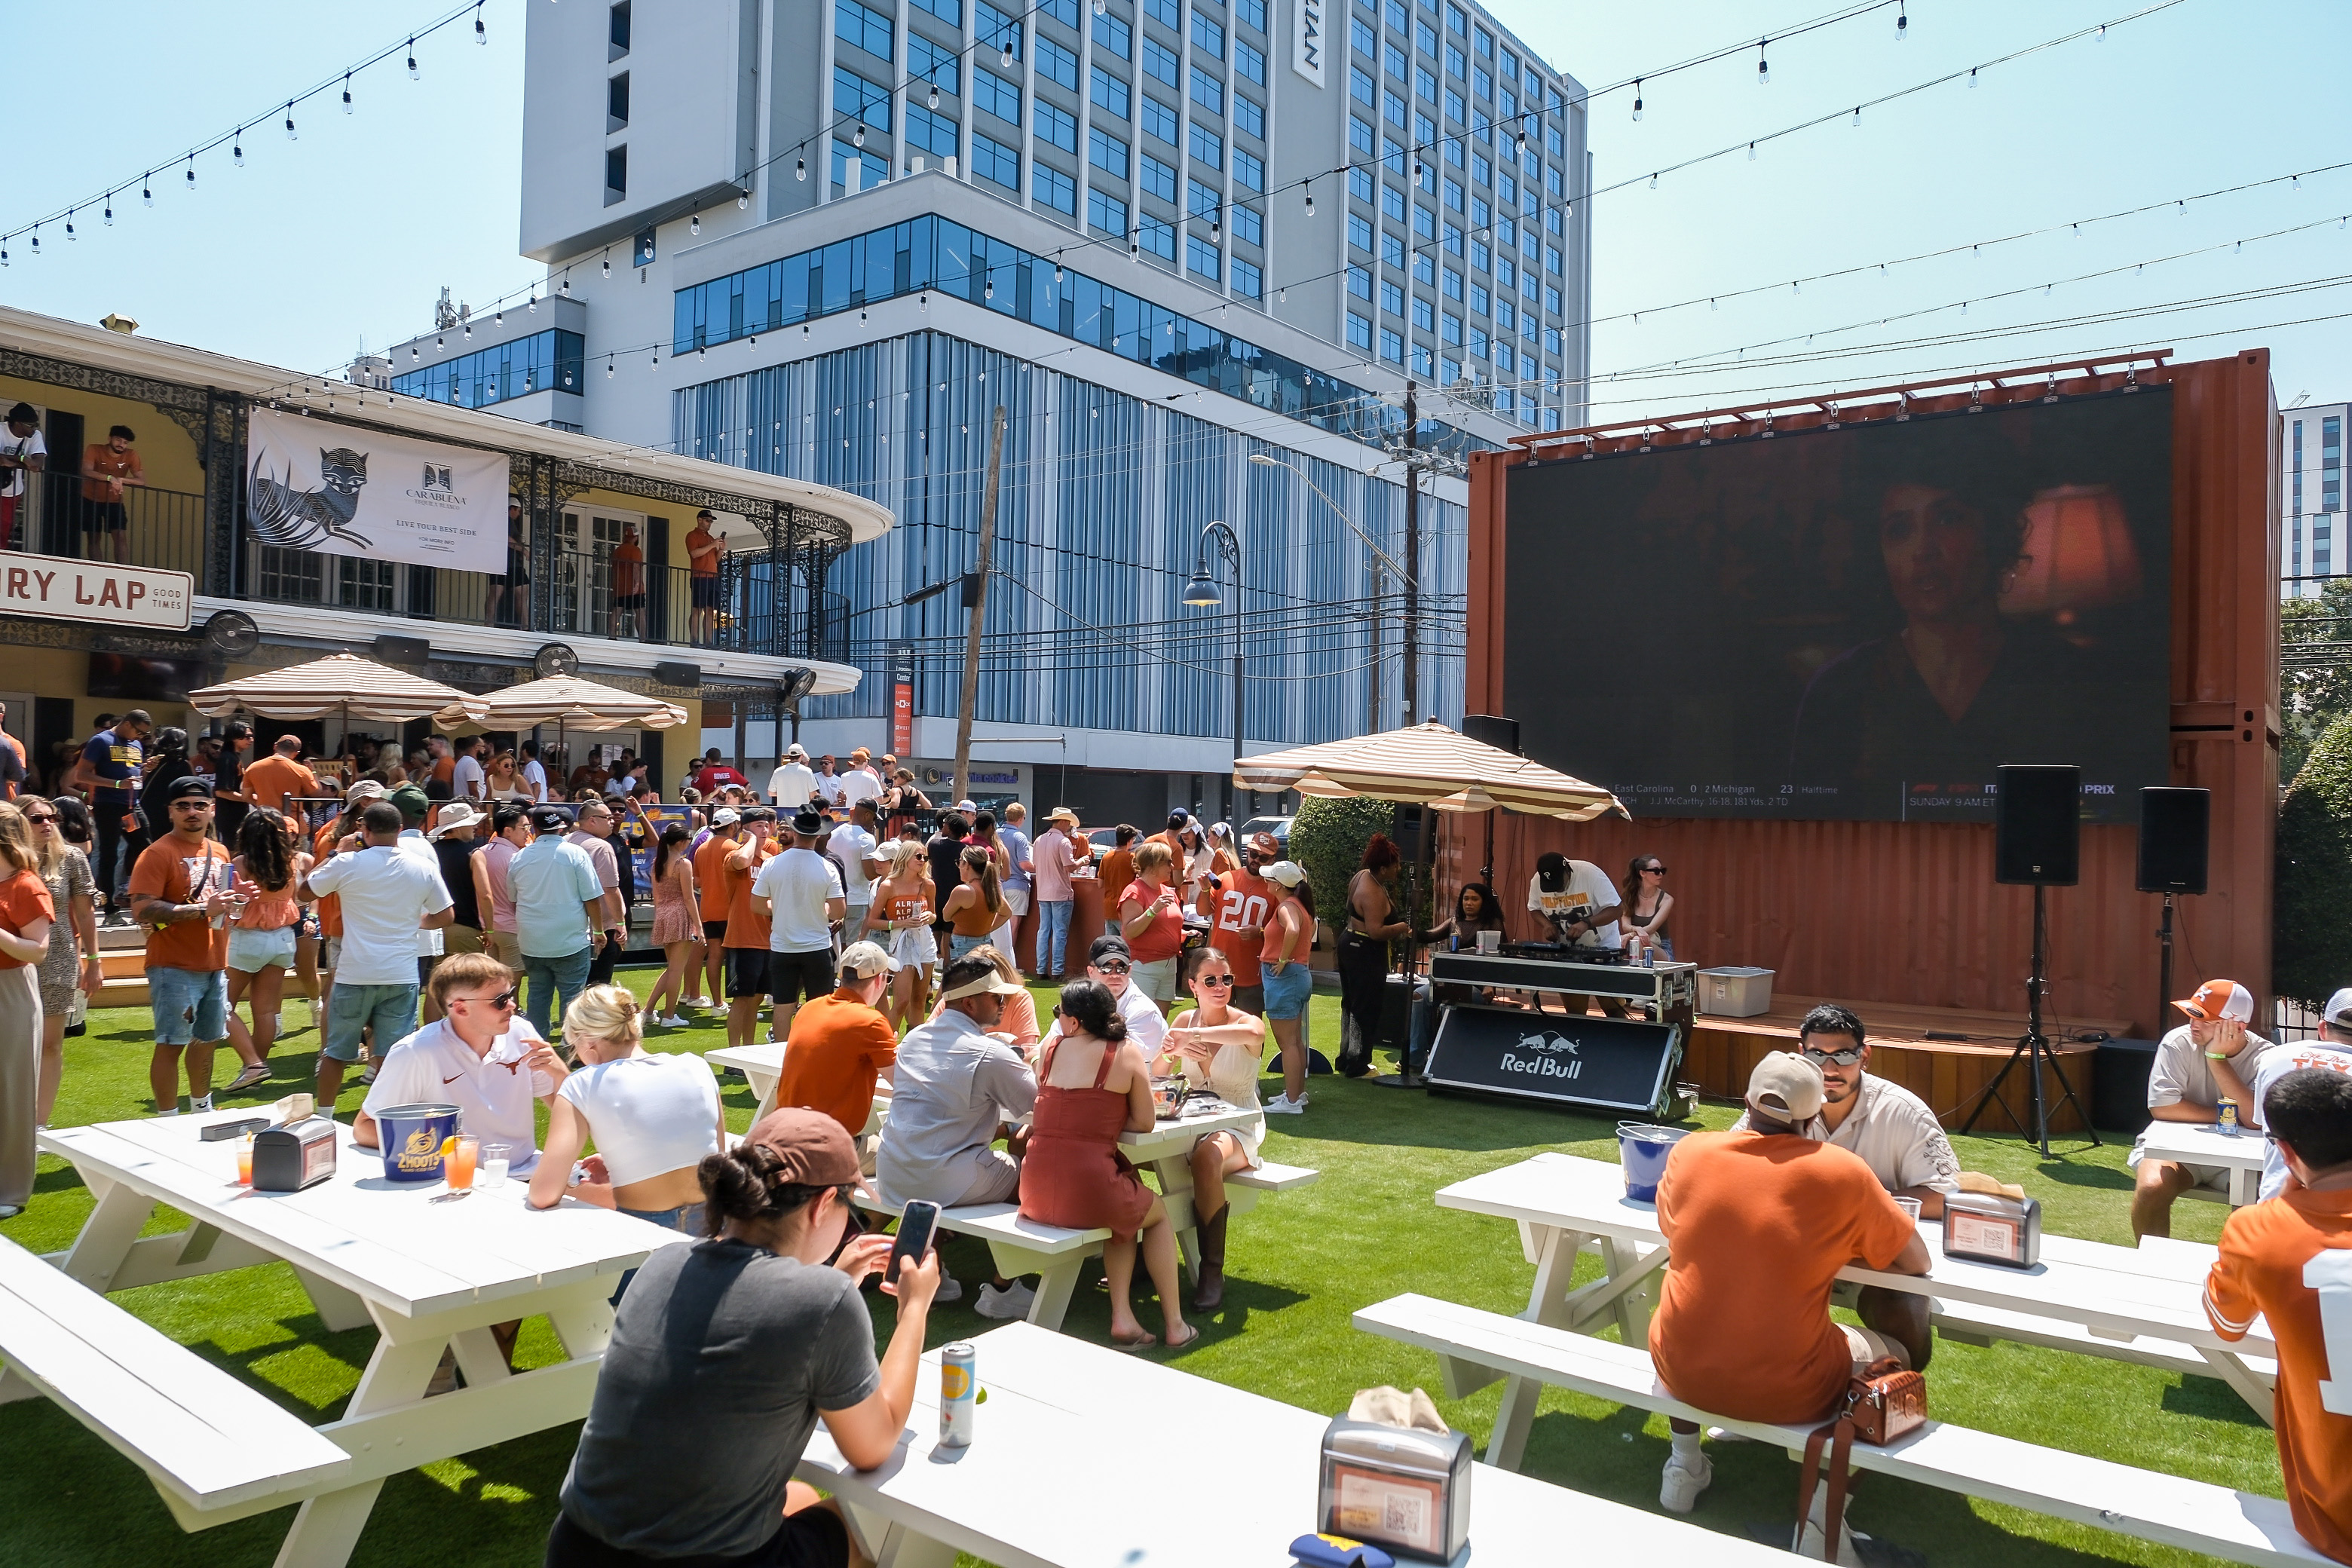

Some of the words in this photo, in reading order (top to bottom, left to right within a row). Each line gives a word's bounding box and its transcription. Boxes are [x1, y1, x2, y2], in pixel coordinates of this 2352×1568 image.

[406, 489, 467, 505] CARABUENA
[417, 522, 437, 531] YOUR
[0, 567, 57, 602] RY
[75, 574, 146, 611] LAP
[153, 588, 182, 599] GOOD
[152, 599, 182, 610] TIMES
[897, 673, 911, 681] Center
[983, 773, 1018, 784] cookies
[1615, 784, 1634, 792] East
[1636, 784, 1674, 792] Carolina
[1690, 784, 1697, 793] 0
[1705, 785, 1710, 793] 2
[1712, 785, 1755, 795] Michigan
[1781, 785, 1793, 794] 23
[1802, 786, 1838, 795] Halftime
[2084, 785, 2115, 795] PRIX
[1735, 798, 1747, 806] 181
[1768, 798, 1774, 806] 2
[1776, 798, 1789, 806] TD
[1909, 798, 1951, 807] SUNDAY
[1955, 798, 1962, 807] 9
[1964, 798, 1981, 807] AM
[1983, 799, 1995, 807] ET
[1219, 890, 1268, 933] 20
[1500, 1053, 1542, 1074] Red
[1540, 1058, 1582, 1080] Bull
[397, 1150, 440, 1168] 2HOOTS
